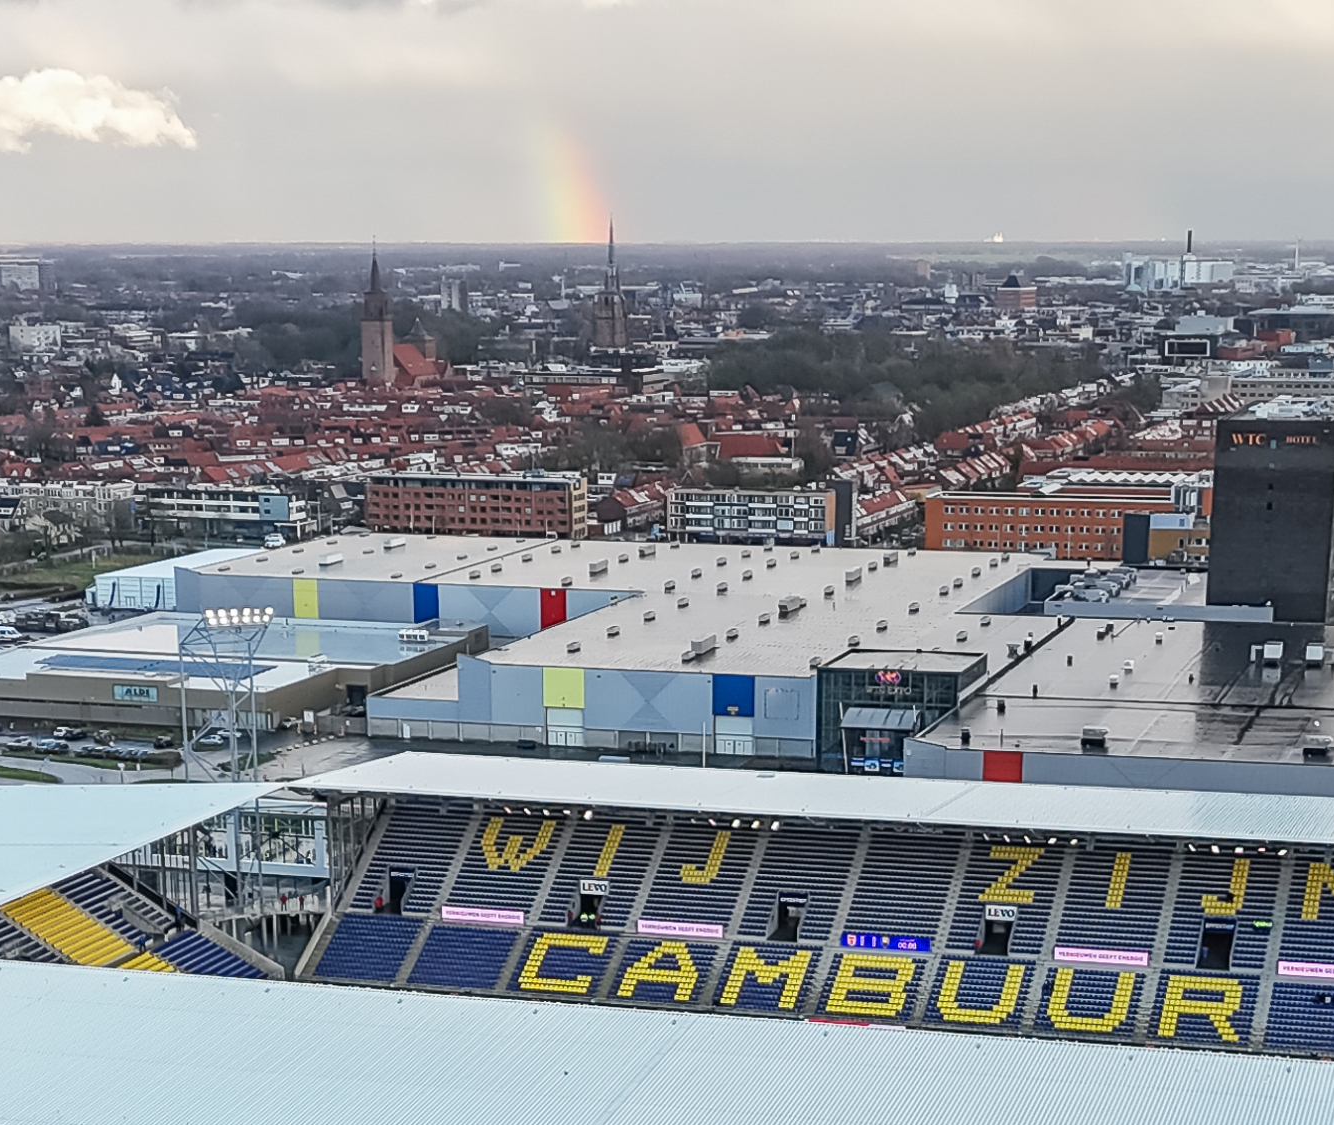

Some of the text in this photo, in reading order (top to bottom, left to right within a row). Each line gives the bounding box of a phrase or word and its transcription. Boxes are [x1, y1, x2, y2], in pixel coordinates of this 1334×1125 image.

[1231, 433, 1318, 445] WTC HOTEL
[125, 687, 150, 697] ALDI
[582, 882, 608, 894] LEVO
[987, 907, 1016, 918] LEVO
[517, 932, 1243, 1041] CAMBUUR
